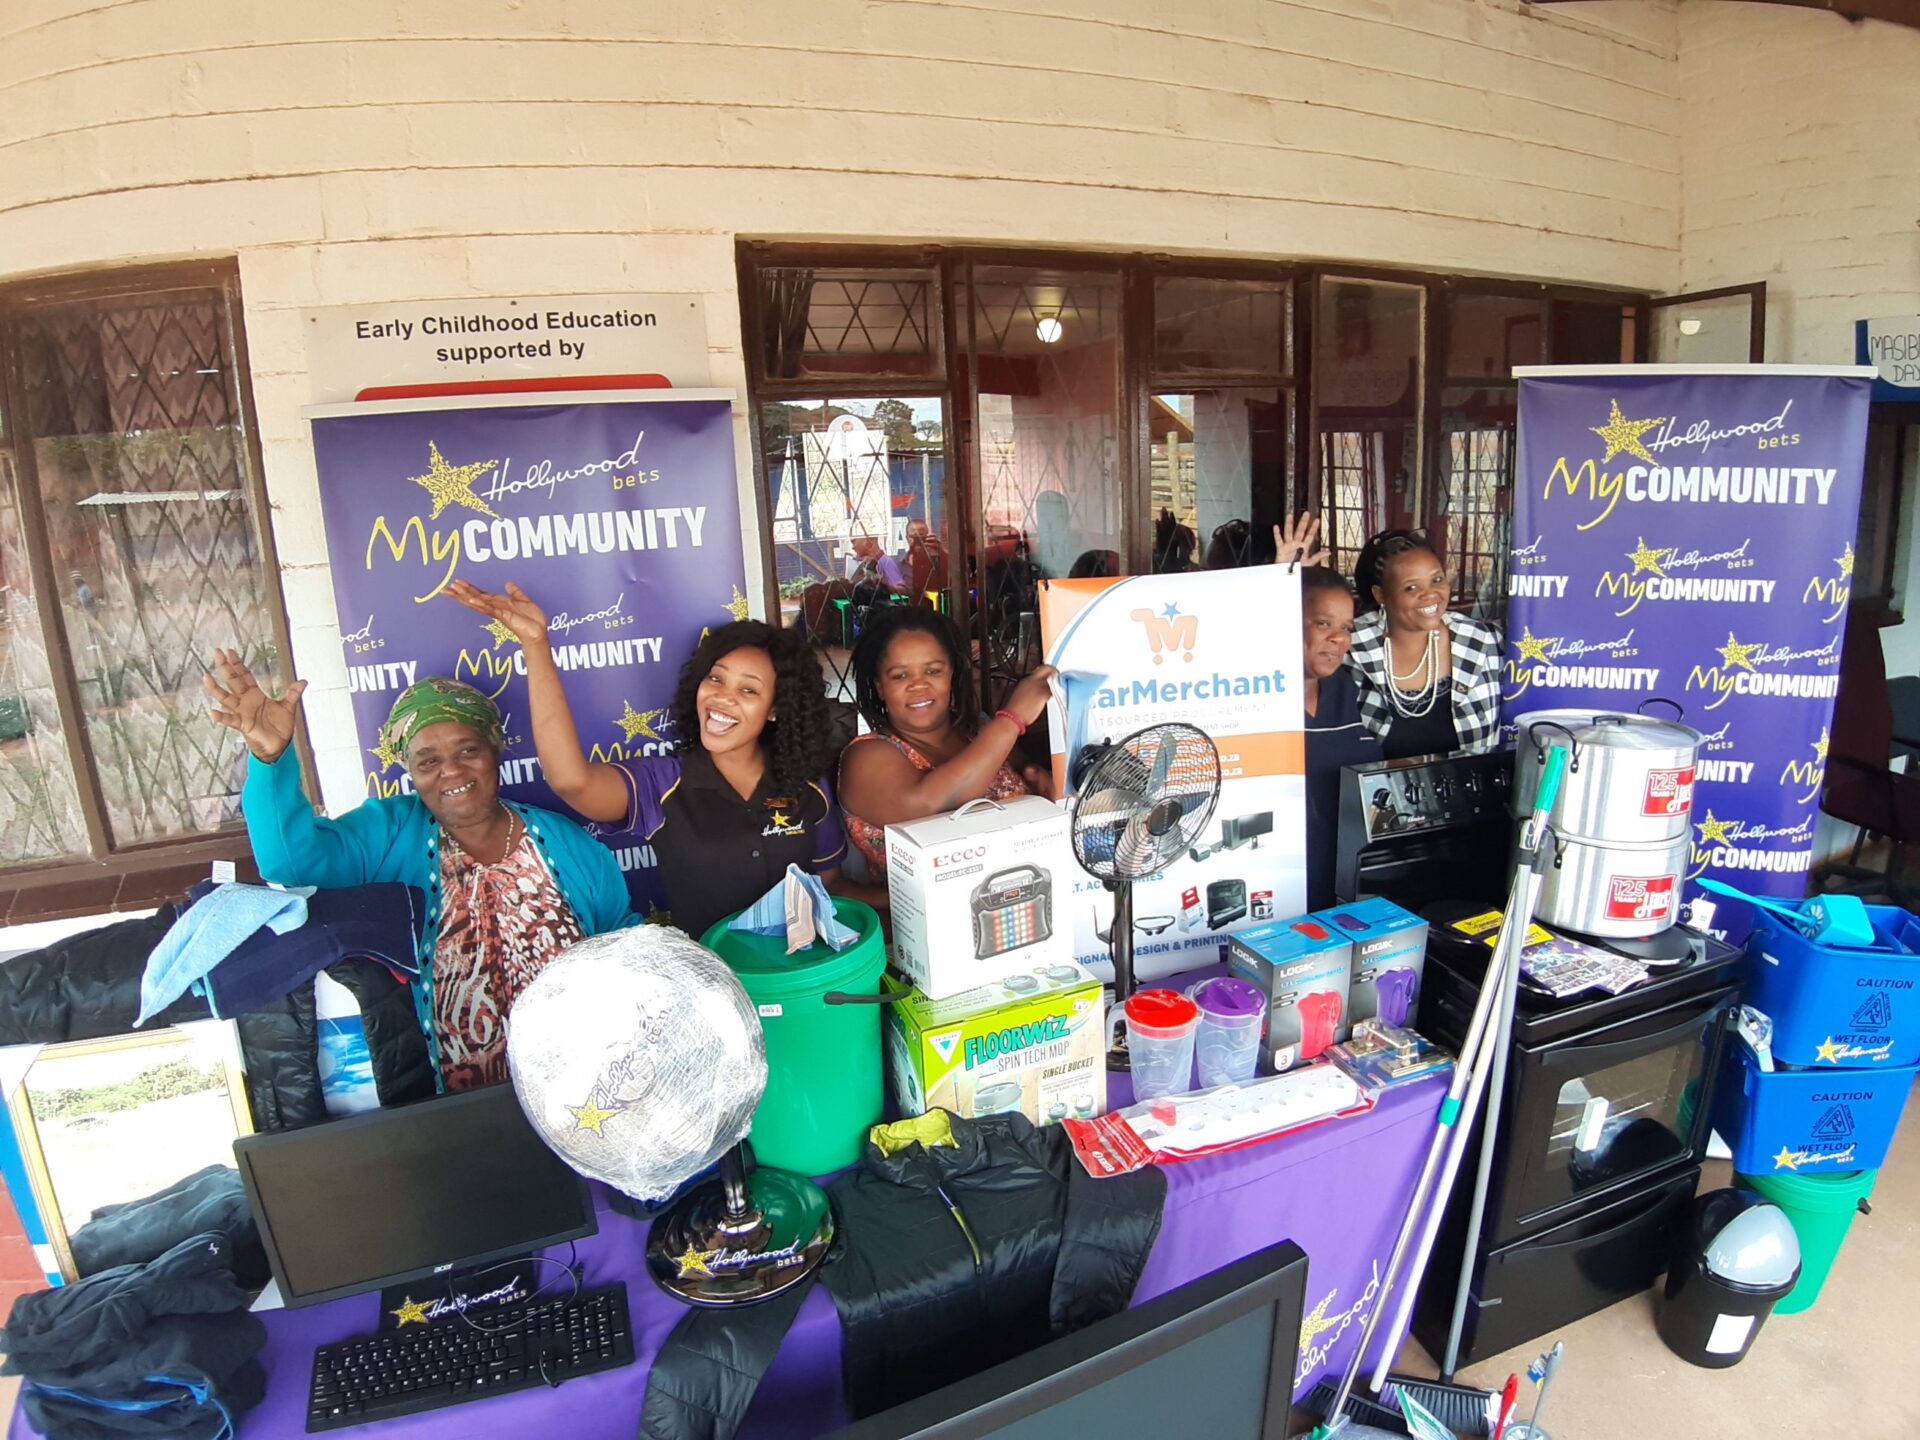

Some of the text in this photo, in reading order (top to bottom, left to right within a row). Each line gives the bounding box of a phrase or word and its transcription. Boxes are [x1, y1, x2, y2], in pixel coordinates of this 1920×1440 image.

[356, 309, 658, 341] Early Childhood Education
[436, 340, 586, 366] supported by
[1647, 399, 1793, 454] Hollywood
[1758, 432, 1801, 450] bets
[481, 431, 645, 504] Hollywood
[612, 466, 660, 491] bets
[1660, 538, 1751, 571] Hollywood
[1727, 557, 1755, 569] bets
[604, 615, 635, 630] bets
[354, 638, 385, 653] bets
[1546, 628, 1635, 660] Hollywood
[1750, 635, 1839, 667] Hollywood
[1726, 814, 1813, 844] Hollywood
[1232, 945, 1258, 969] LOGIK
[1361, 940, 1393, 955] LOGIK
[1280, 962, 1315, 978] LOGIK
[1856, 978, 1914, 989] CAUTION
[964, 1014, 1070, 1071] FLOORWIZ
[998, 1056, 1021, 1073] SPIN
[1024, 1049, 1046, 1064] TECH
[1042, 1056, 1095, 1080] SINGLE BUCKET
[1811, 1091, 1874, 1102] CAUTION
[707, 1239, 800, 1269] Hollywood
[777, 1255, 804, 1268] bets
